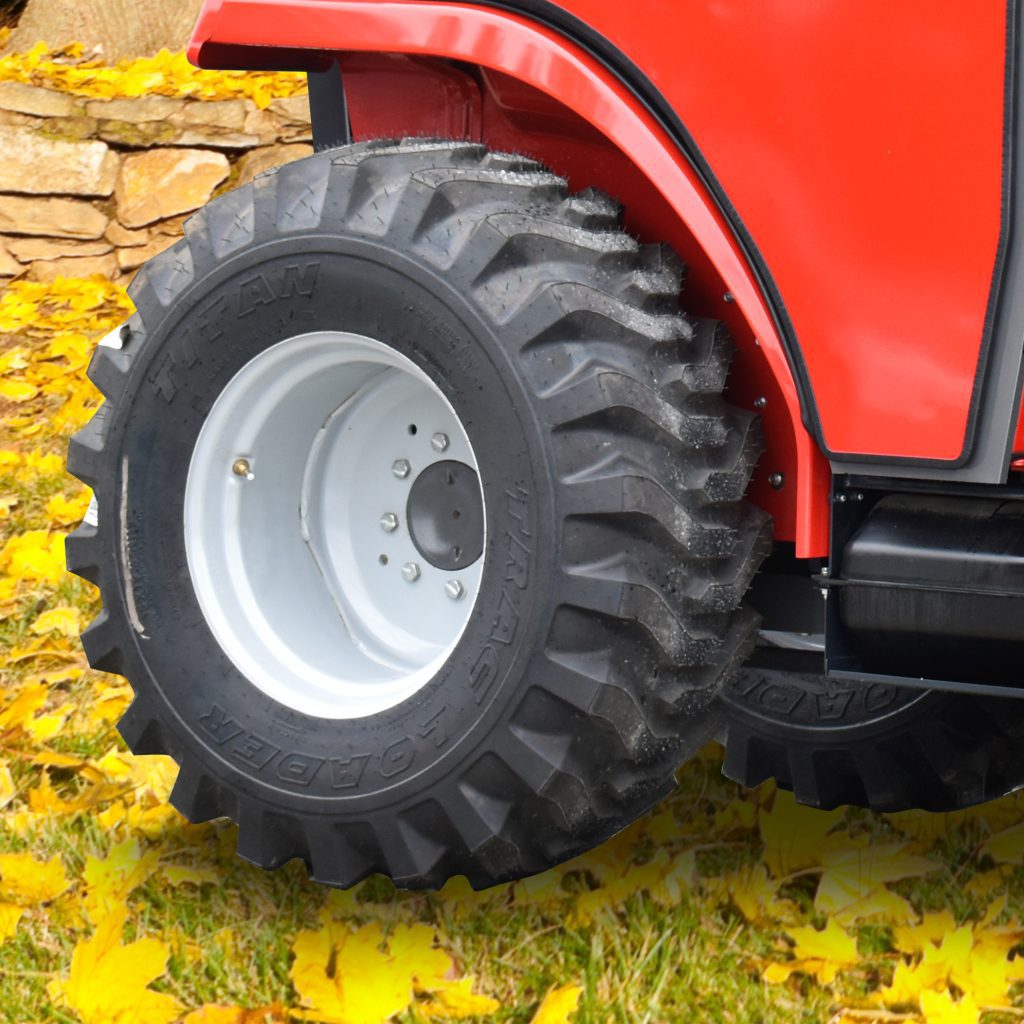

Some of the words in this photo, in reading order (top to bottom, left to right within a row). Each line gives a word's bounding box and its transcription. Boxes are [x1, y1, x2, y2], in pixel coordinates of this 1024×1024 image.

[148, 262, 321, 406] TITAN
[468, 485, 532, 706] TRAC
[200, 703, 450, 789] LOADER
